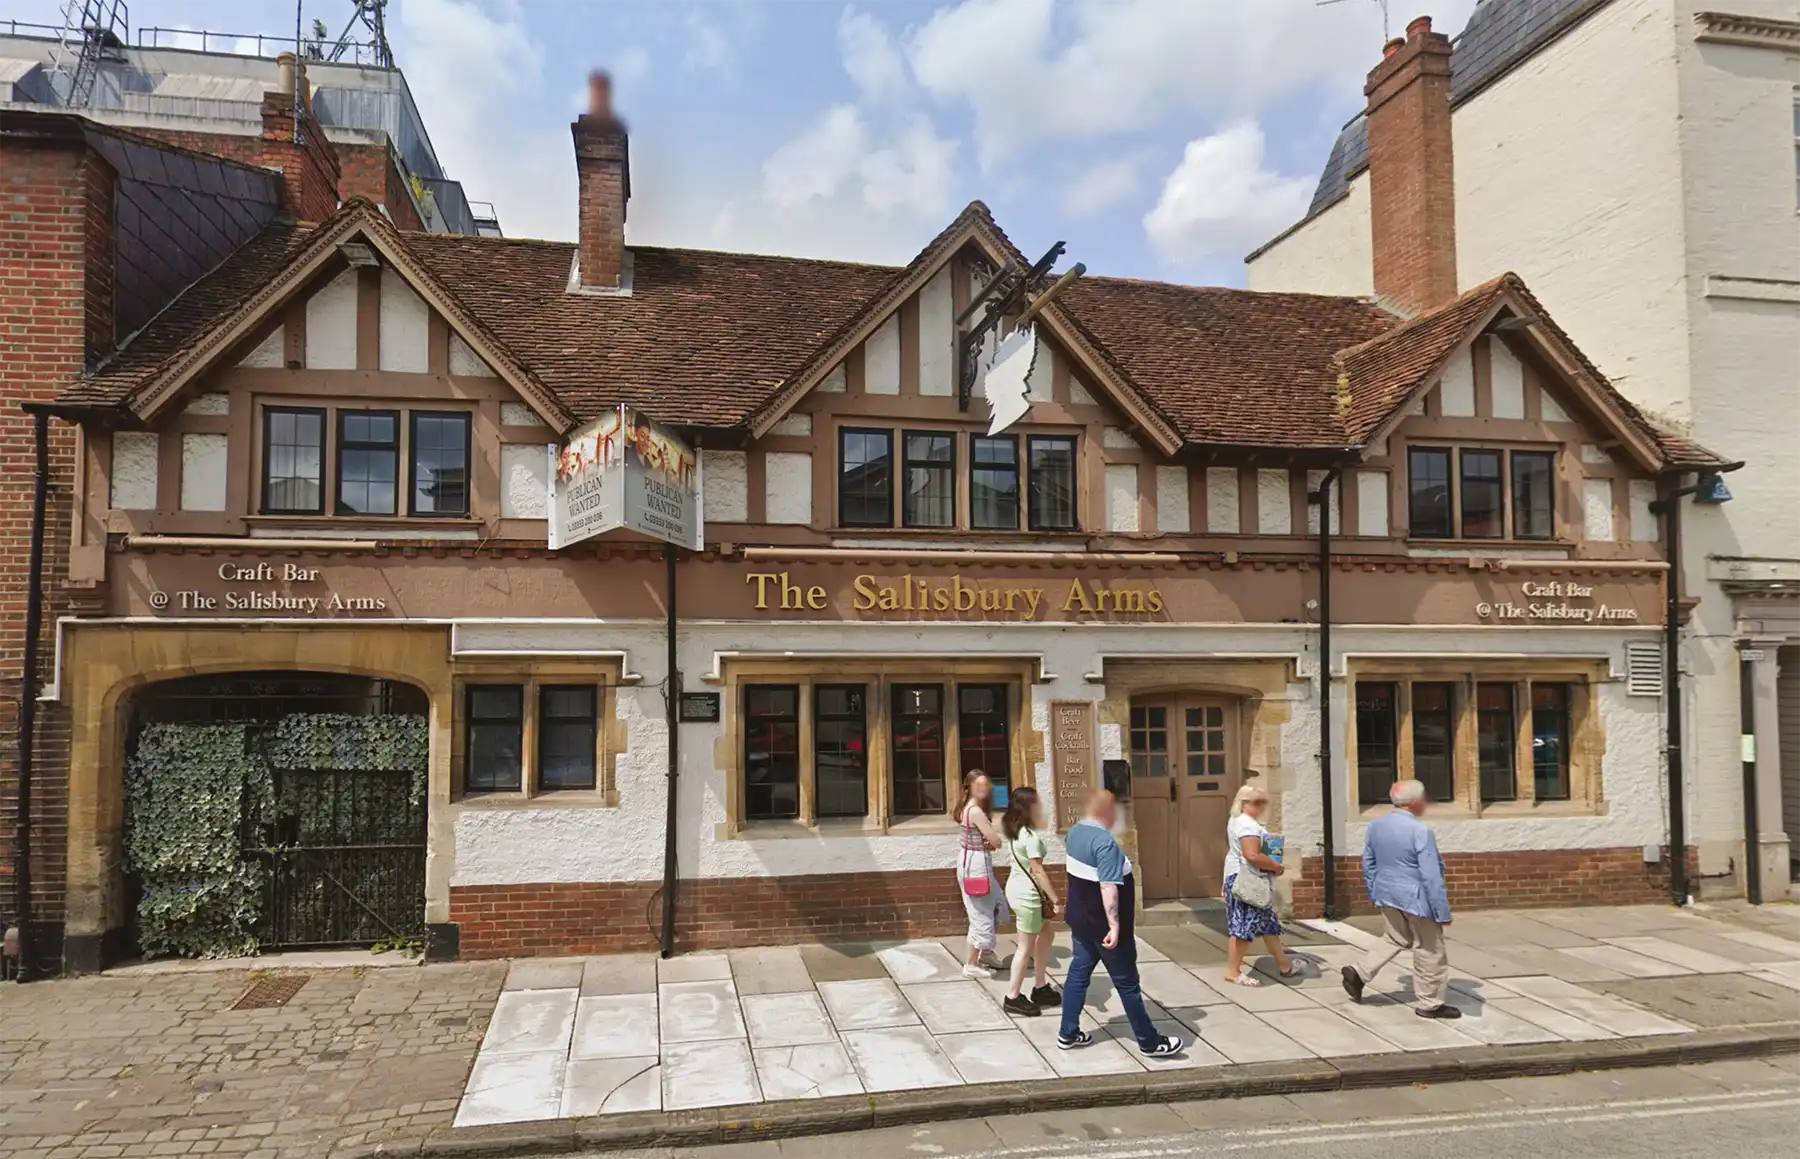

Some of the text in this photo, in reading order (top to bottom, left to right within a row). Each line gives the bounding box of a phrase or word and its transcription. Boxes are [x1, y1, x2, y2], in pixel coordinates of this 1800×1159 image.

[567, 475, 604, 504] PUBLICAN
[644, 476, 683, 504] PUBLICAN
[569, 493, 601, 517] WANTED
[647, 493, 682, 519] WANTED
[218, 562, 320, 582] Craft Bar
[745, 571, 1163, 621] The Salisbury Arms
[1521, 581, 1593, 598] Craft Bar
[149, 590, 386, 613] @ The Salisbury Arms
[1476, 602, 1638, 622] @ The Salisbury Arms
[1060, 707, 1082, 717] Craft
[1062, 716, 1081, 726] Beer
[1060, 731, 1084, 741] Craft
[1064, 765, 1084, 775] Food
